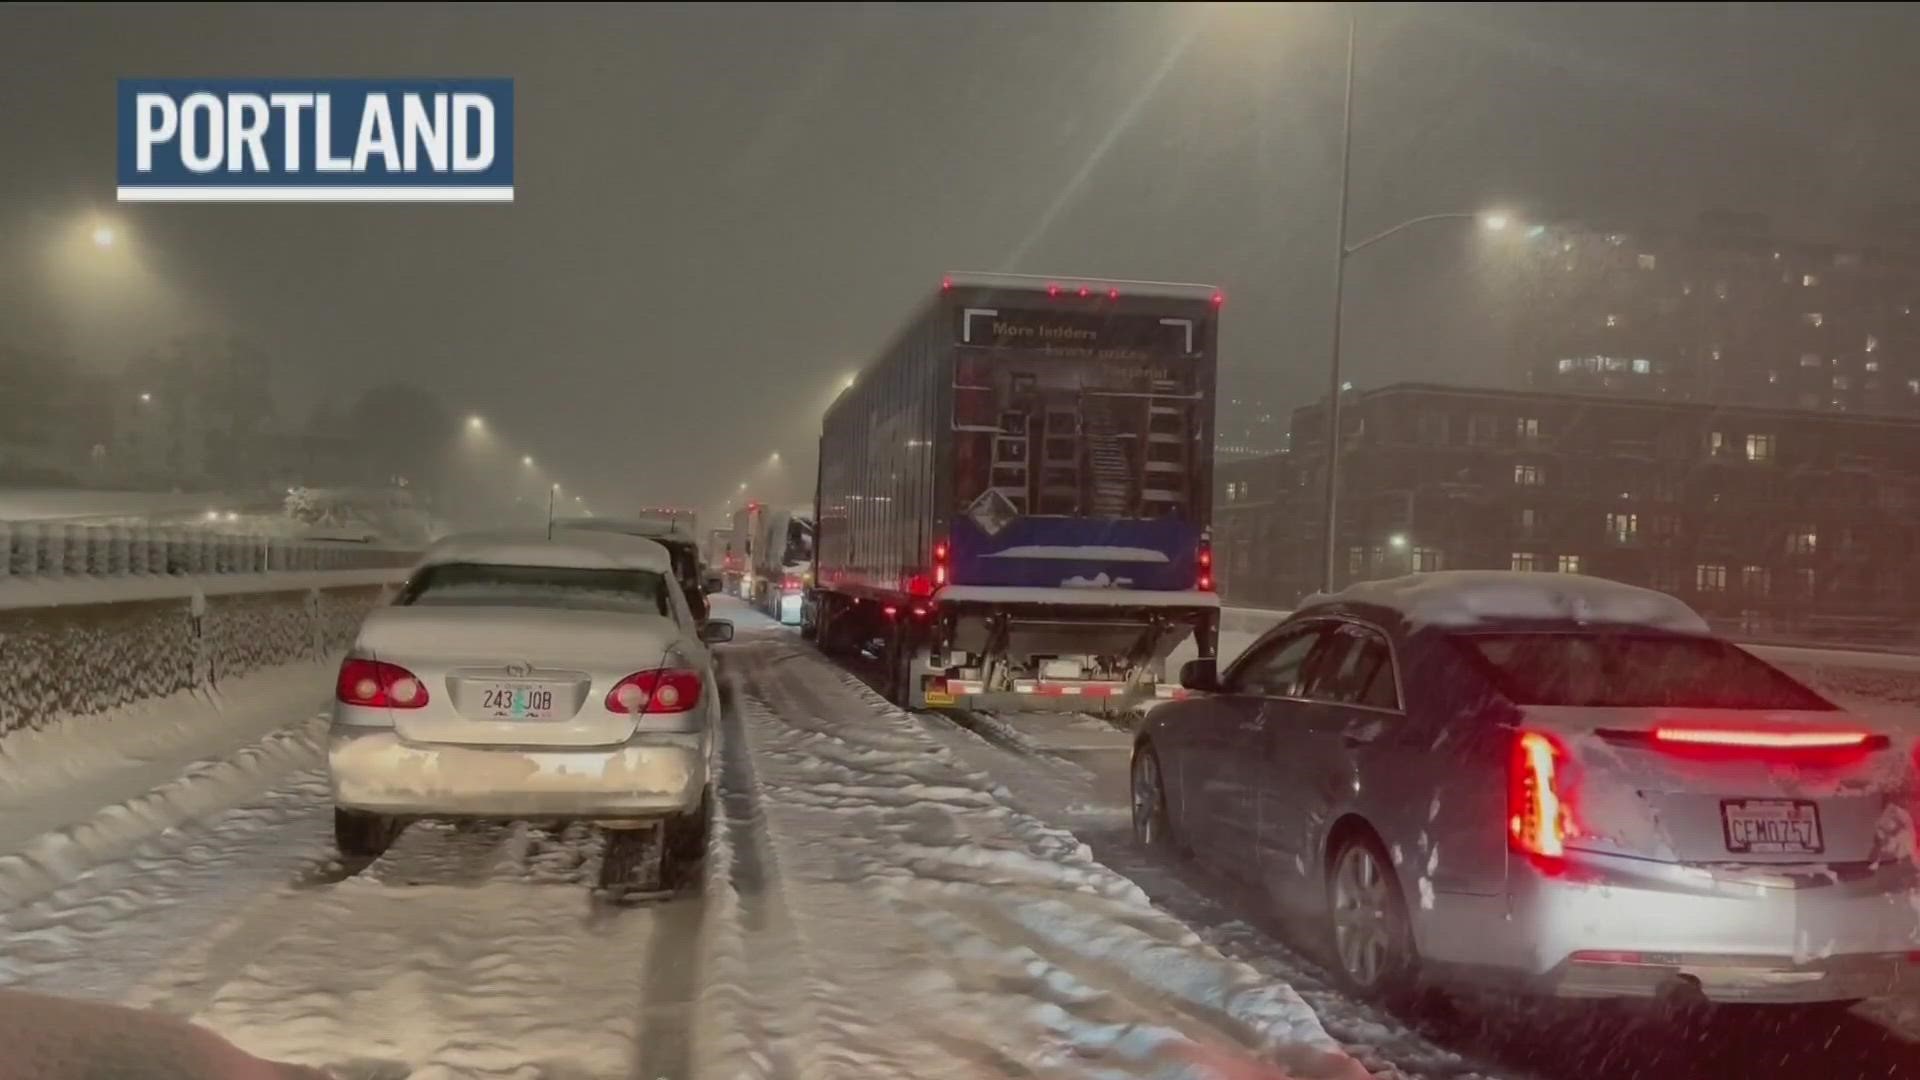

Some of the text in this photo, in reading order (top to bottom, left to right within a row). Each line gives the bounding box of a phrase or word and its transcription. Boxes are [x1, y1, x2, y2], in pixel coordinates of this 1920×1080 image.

[992, 321, 1034, 338] More
[483, 689, 552, 711] 243 JQB
